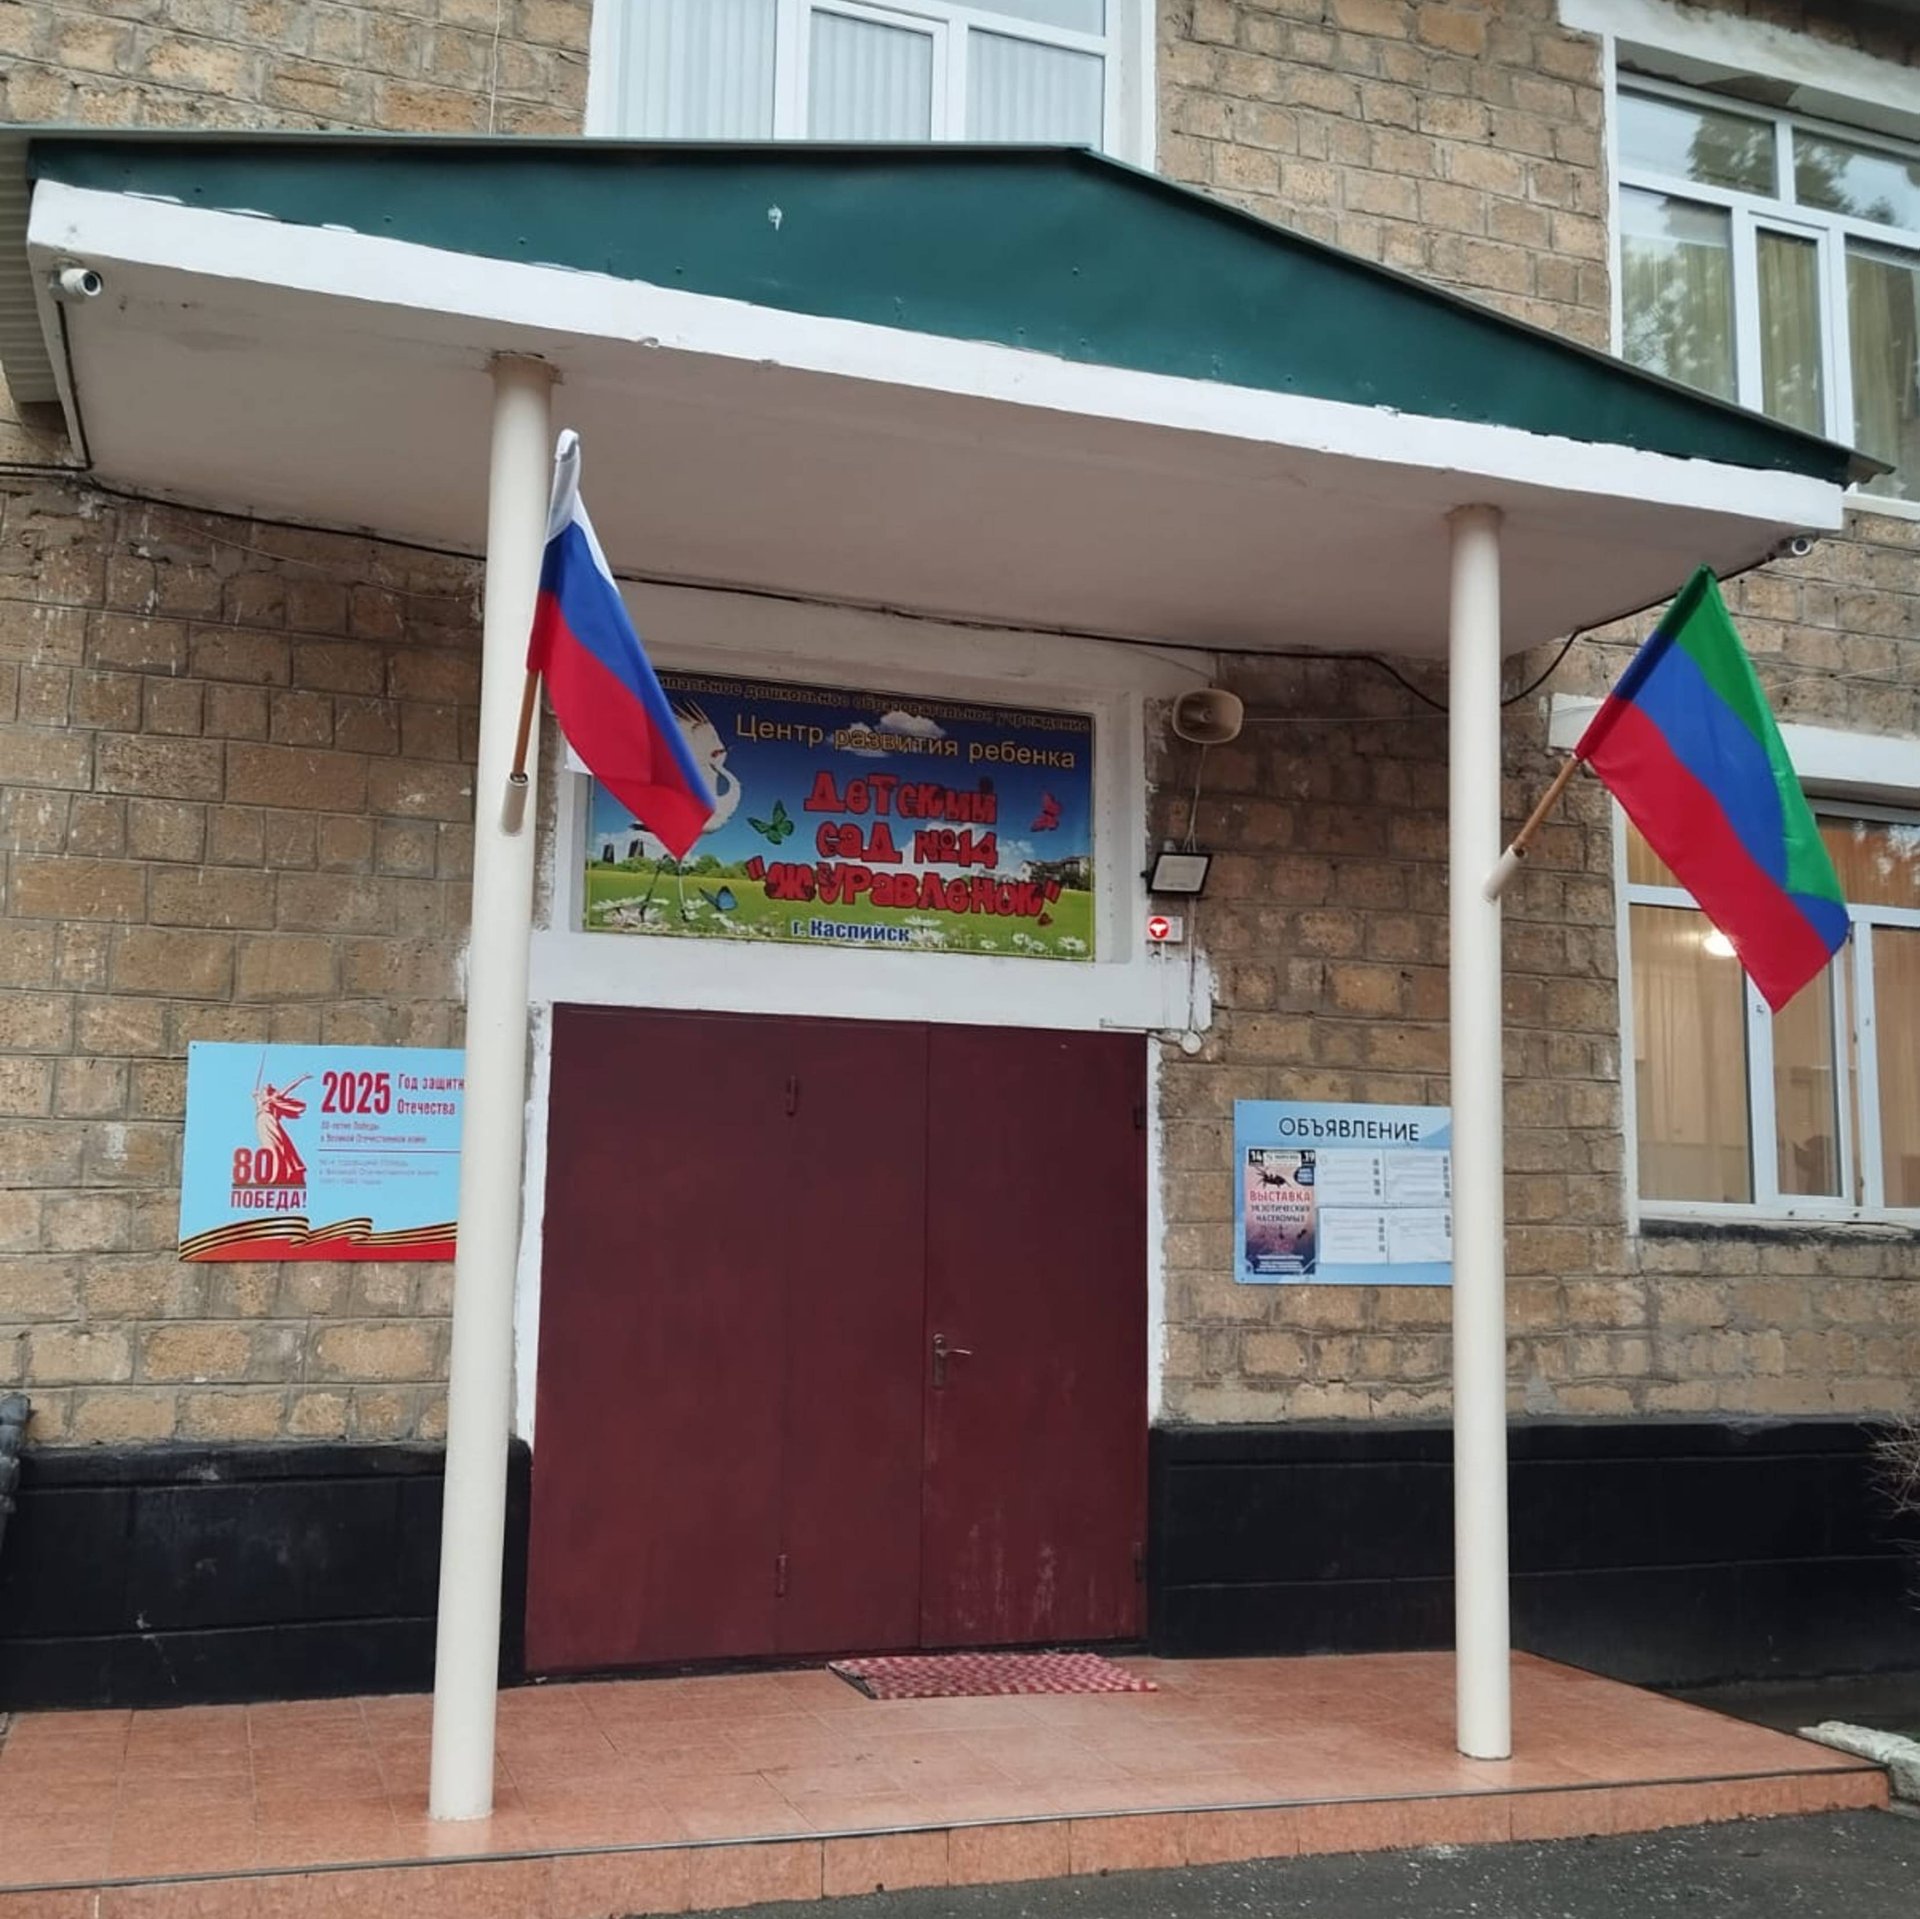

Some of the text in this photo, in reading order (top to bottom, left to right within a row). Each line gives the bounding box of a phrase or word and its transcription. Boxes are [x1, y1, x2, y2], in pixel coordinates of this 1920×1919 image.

[736, 713, 1076, 769] Центр развития ребенка
[913, 828, 999, 870] №14
[791, 918, 911, 942] г. Каспийск
[320, 1070, 391, 1115] 2025
[398, 1073, 466, 1092] Год защитн
[397, 1098, 456, 1116] Отечества
[1278, 1116, 1420, 1142] ОБЪЯВЛЕНИЕ
[232, 1147, 274, 1185] 80
[230, 1190, 308, 1211] ПОБЕДА!
[1249, 1190, 1311, 1202] ВЫСТАВКА
